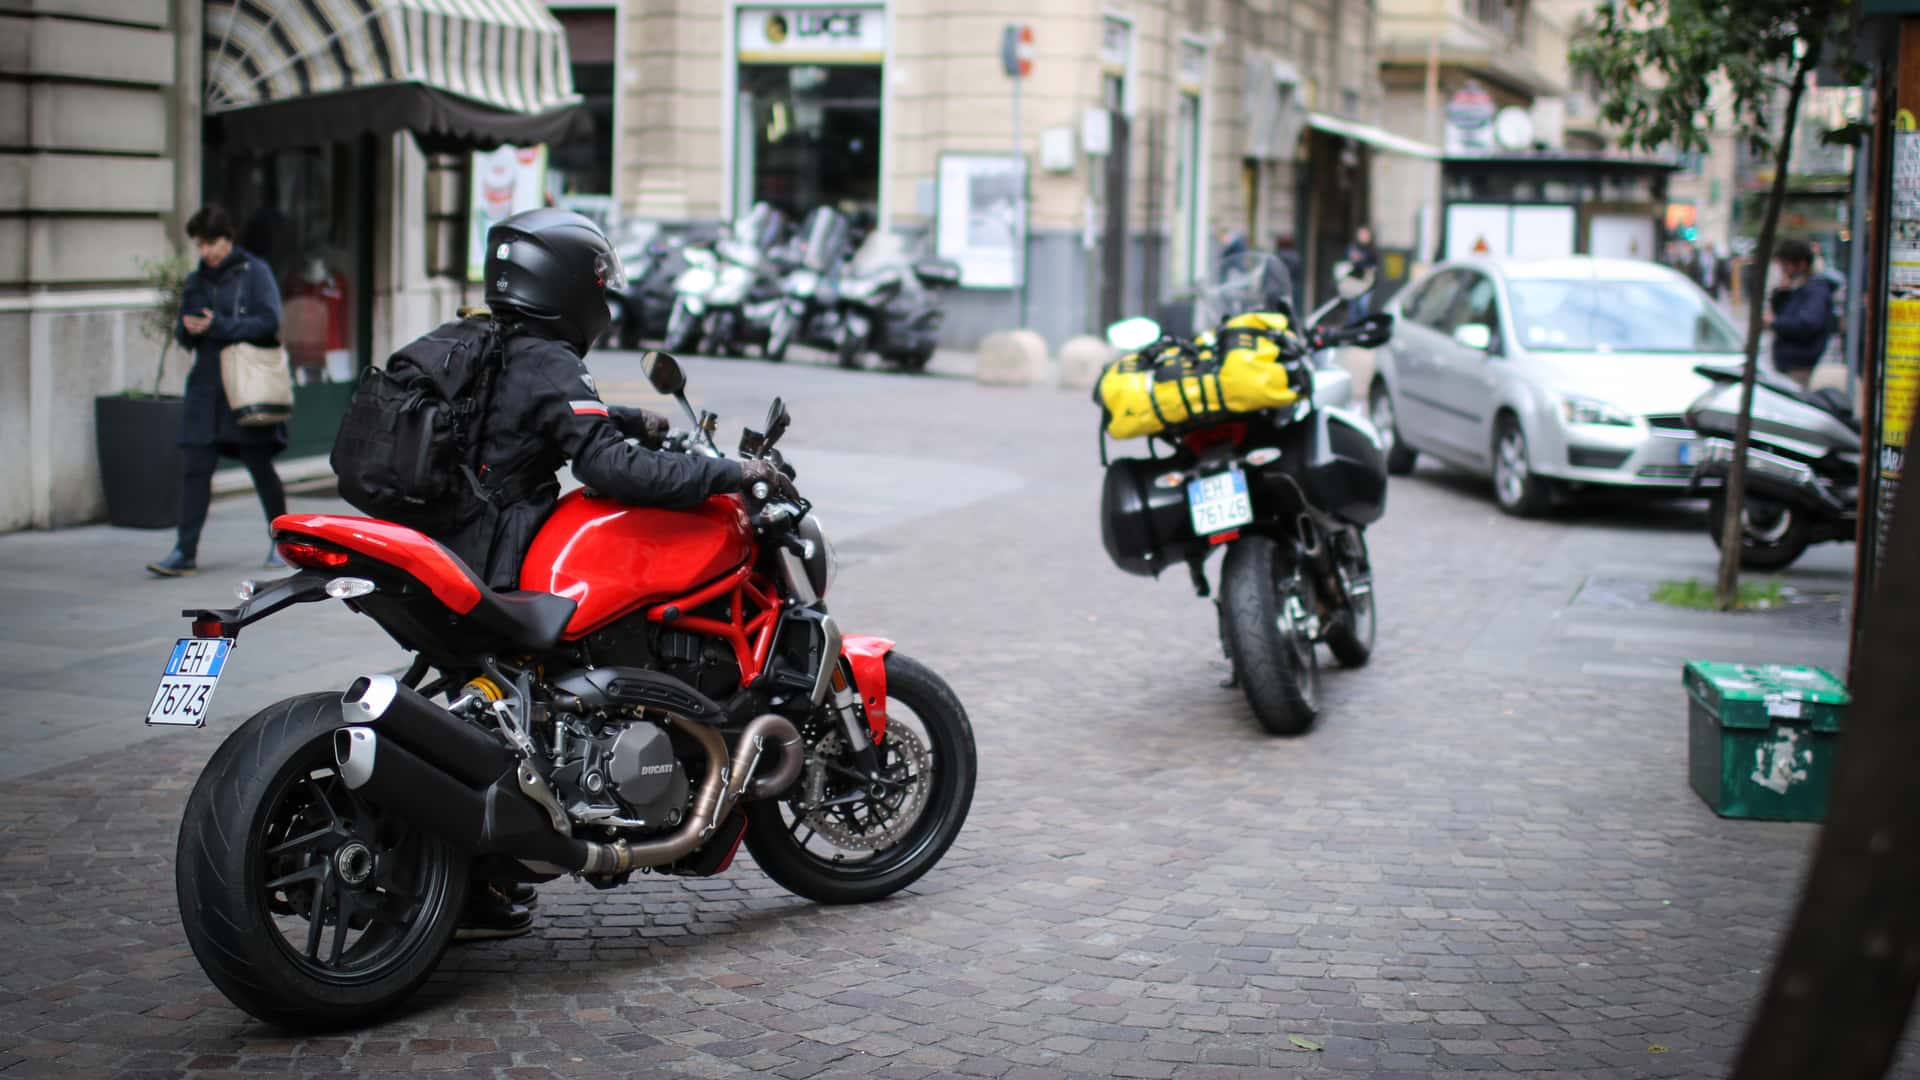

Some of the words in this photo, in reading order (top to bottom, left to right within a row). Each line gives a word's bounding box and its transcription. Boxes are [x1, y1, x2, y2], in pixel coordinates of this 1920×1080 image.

[797, 13, 862, 37] LUCE
[1202, 478, 1226, 501] EH
[179, 641, 209, 673] EH
[151, 683, 211, 716] 76743
[641, 764, 673, 776] DUCATI
